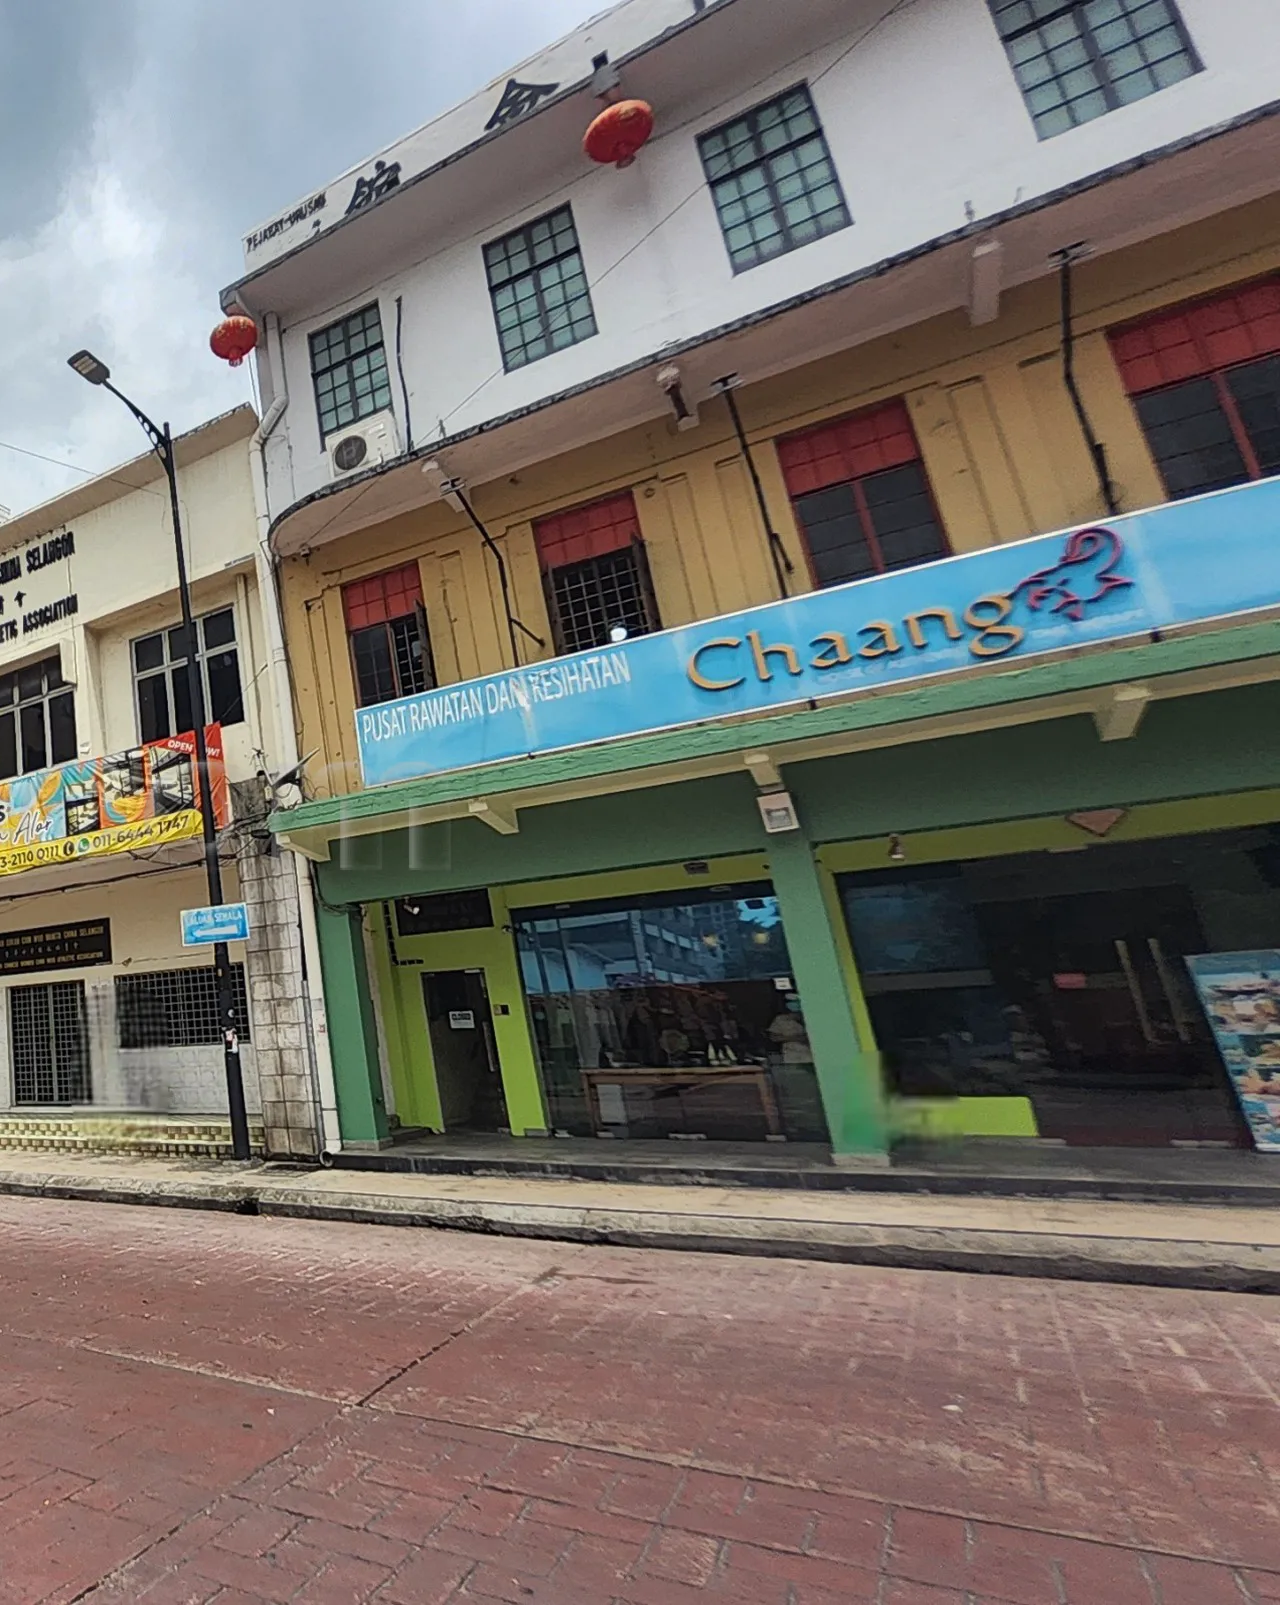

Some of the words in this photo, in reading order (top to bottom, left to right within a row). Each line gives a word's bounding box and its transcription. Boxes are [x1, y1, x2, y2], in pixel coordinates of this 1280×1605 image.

[25, 531, 75, 574] SELANGOR
[23, 593, 78, 635] ASSOCIATION
[686, 592, 1025, 691] Chaang
[363, 705, 407, 743] PUSAT
[409, 685, 484, 732] RAWATAN
[485, 675, 530, 714] DAN
[167, 740, 194, 752] OPEN
[12, 811, 52, 844] Alor
[36, 845, 60, 860] 0111
[92, 824, 155, 849] 011-6444
